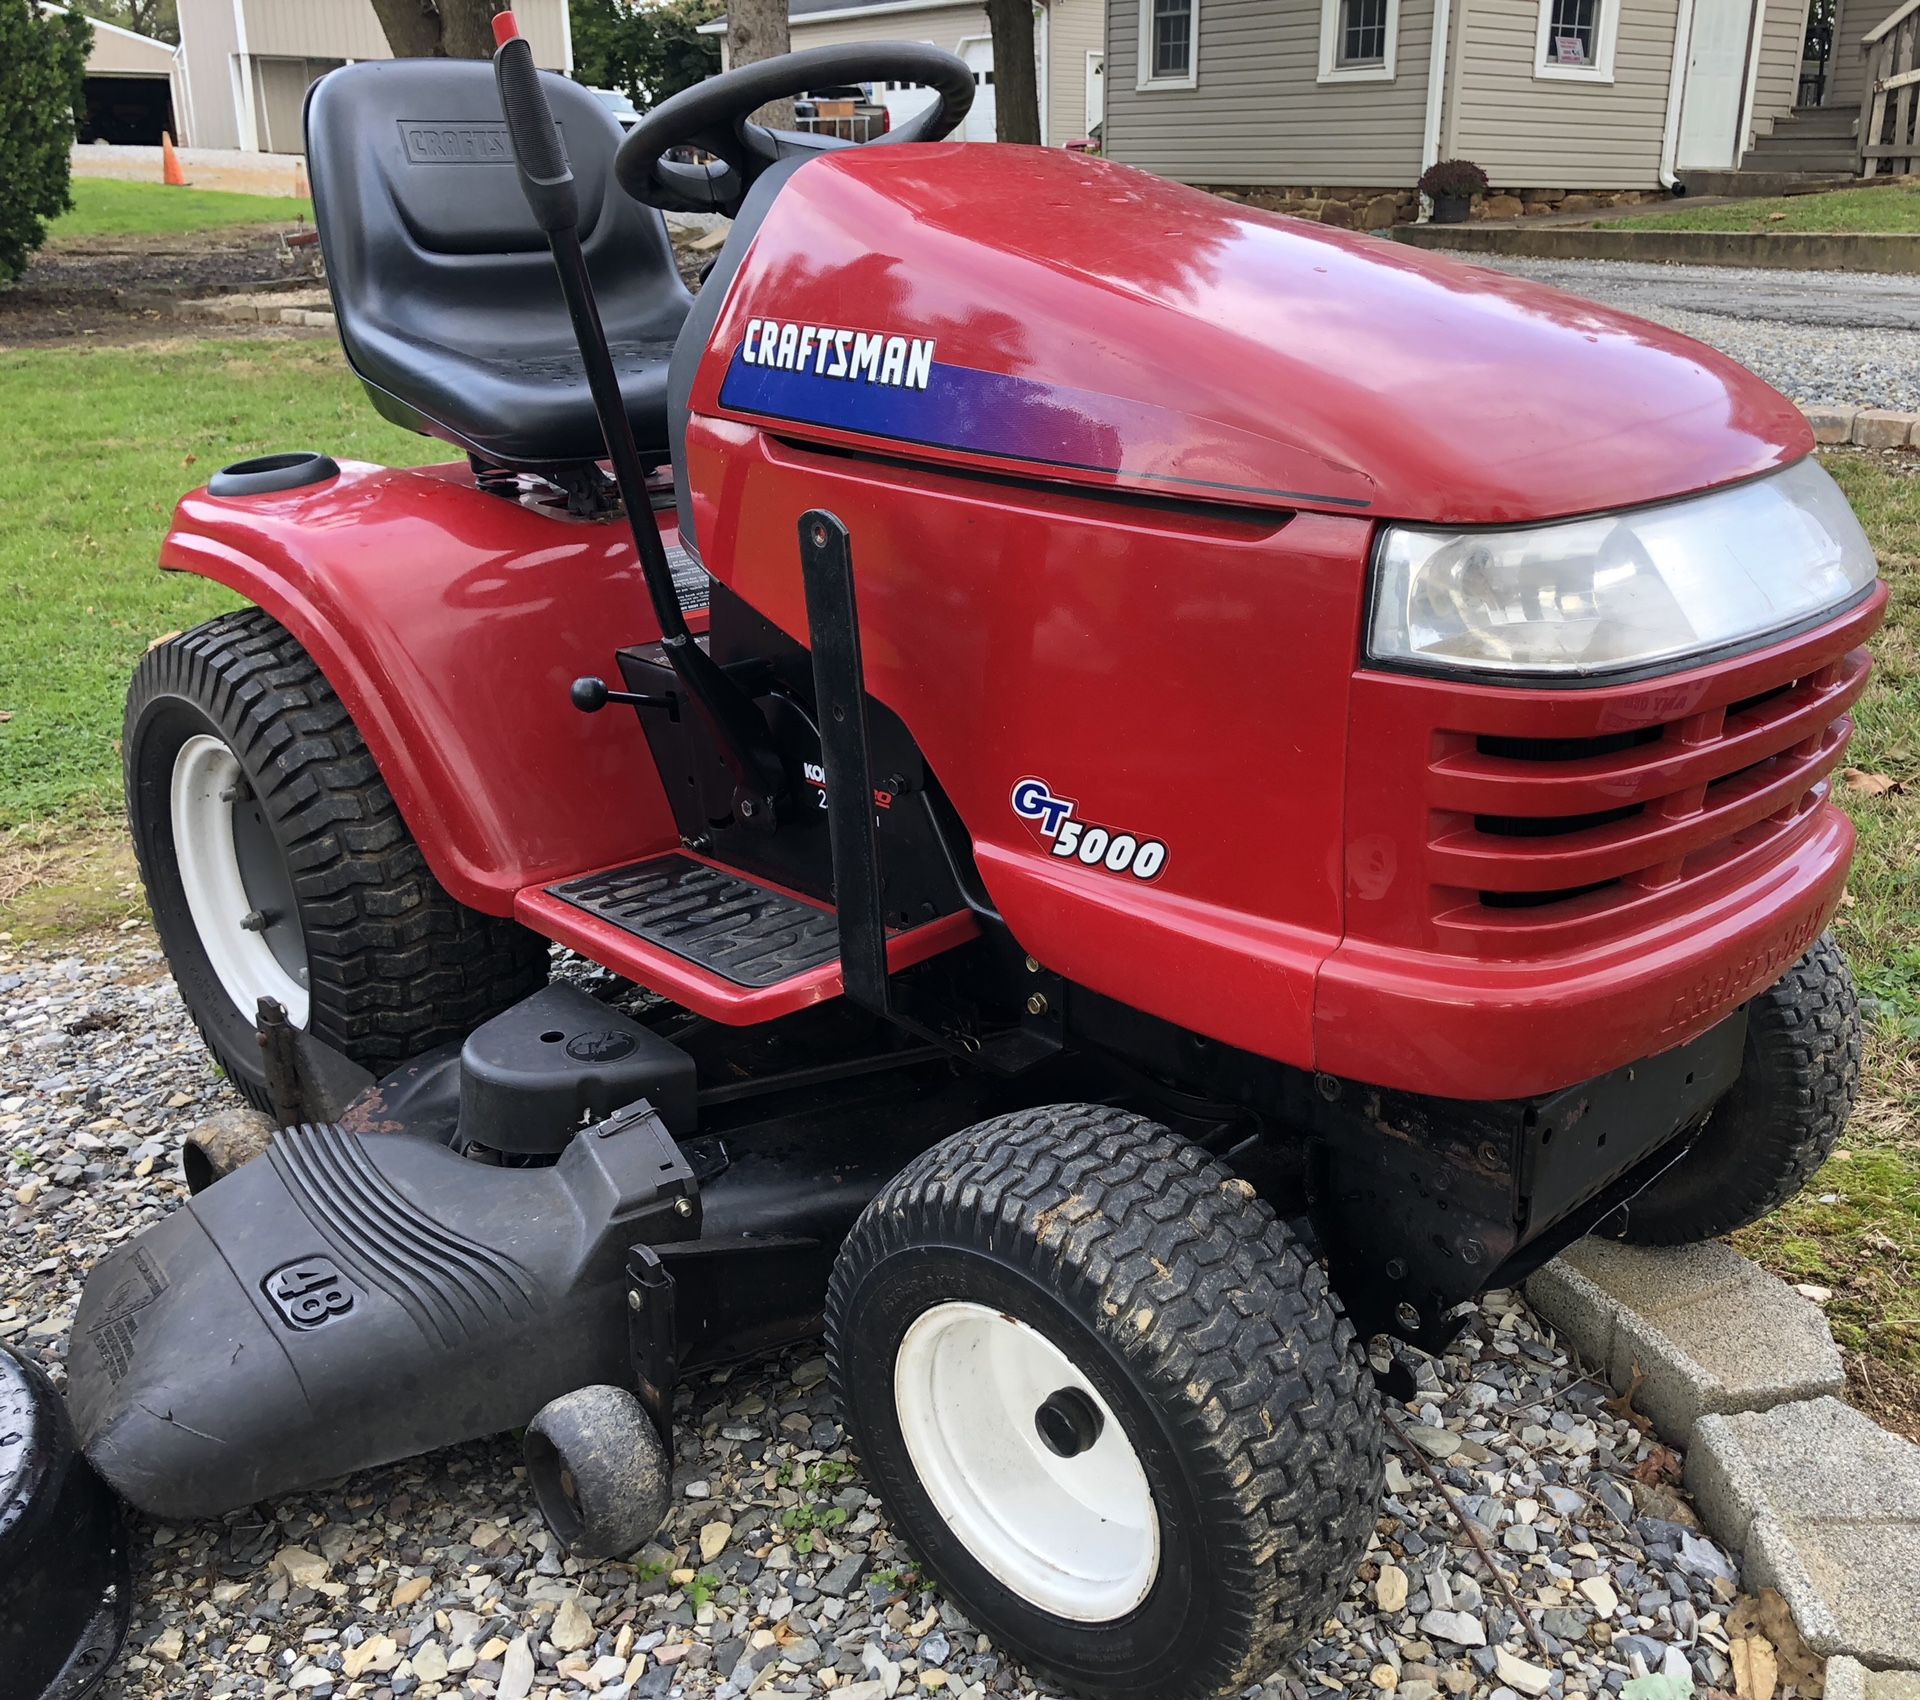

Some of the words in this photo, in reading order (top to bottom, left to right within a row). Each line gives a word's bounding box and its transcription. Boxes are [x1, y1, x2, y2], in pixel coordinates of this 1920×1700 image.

[408, 129, 515, 157] CRAFTS
[742, 318, 935, 391] CRAFTSMAN
[1011, 779, 1074, 838] GT
[1052, 819, 1166, 879] 5000
[276, 1263, 356, 1328] 48
